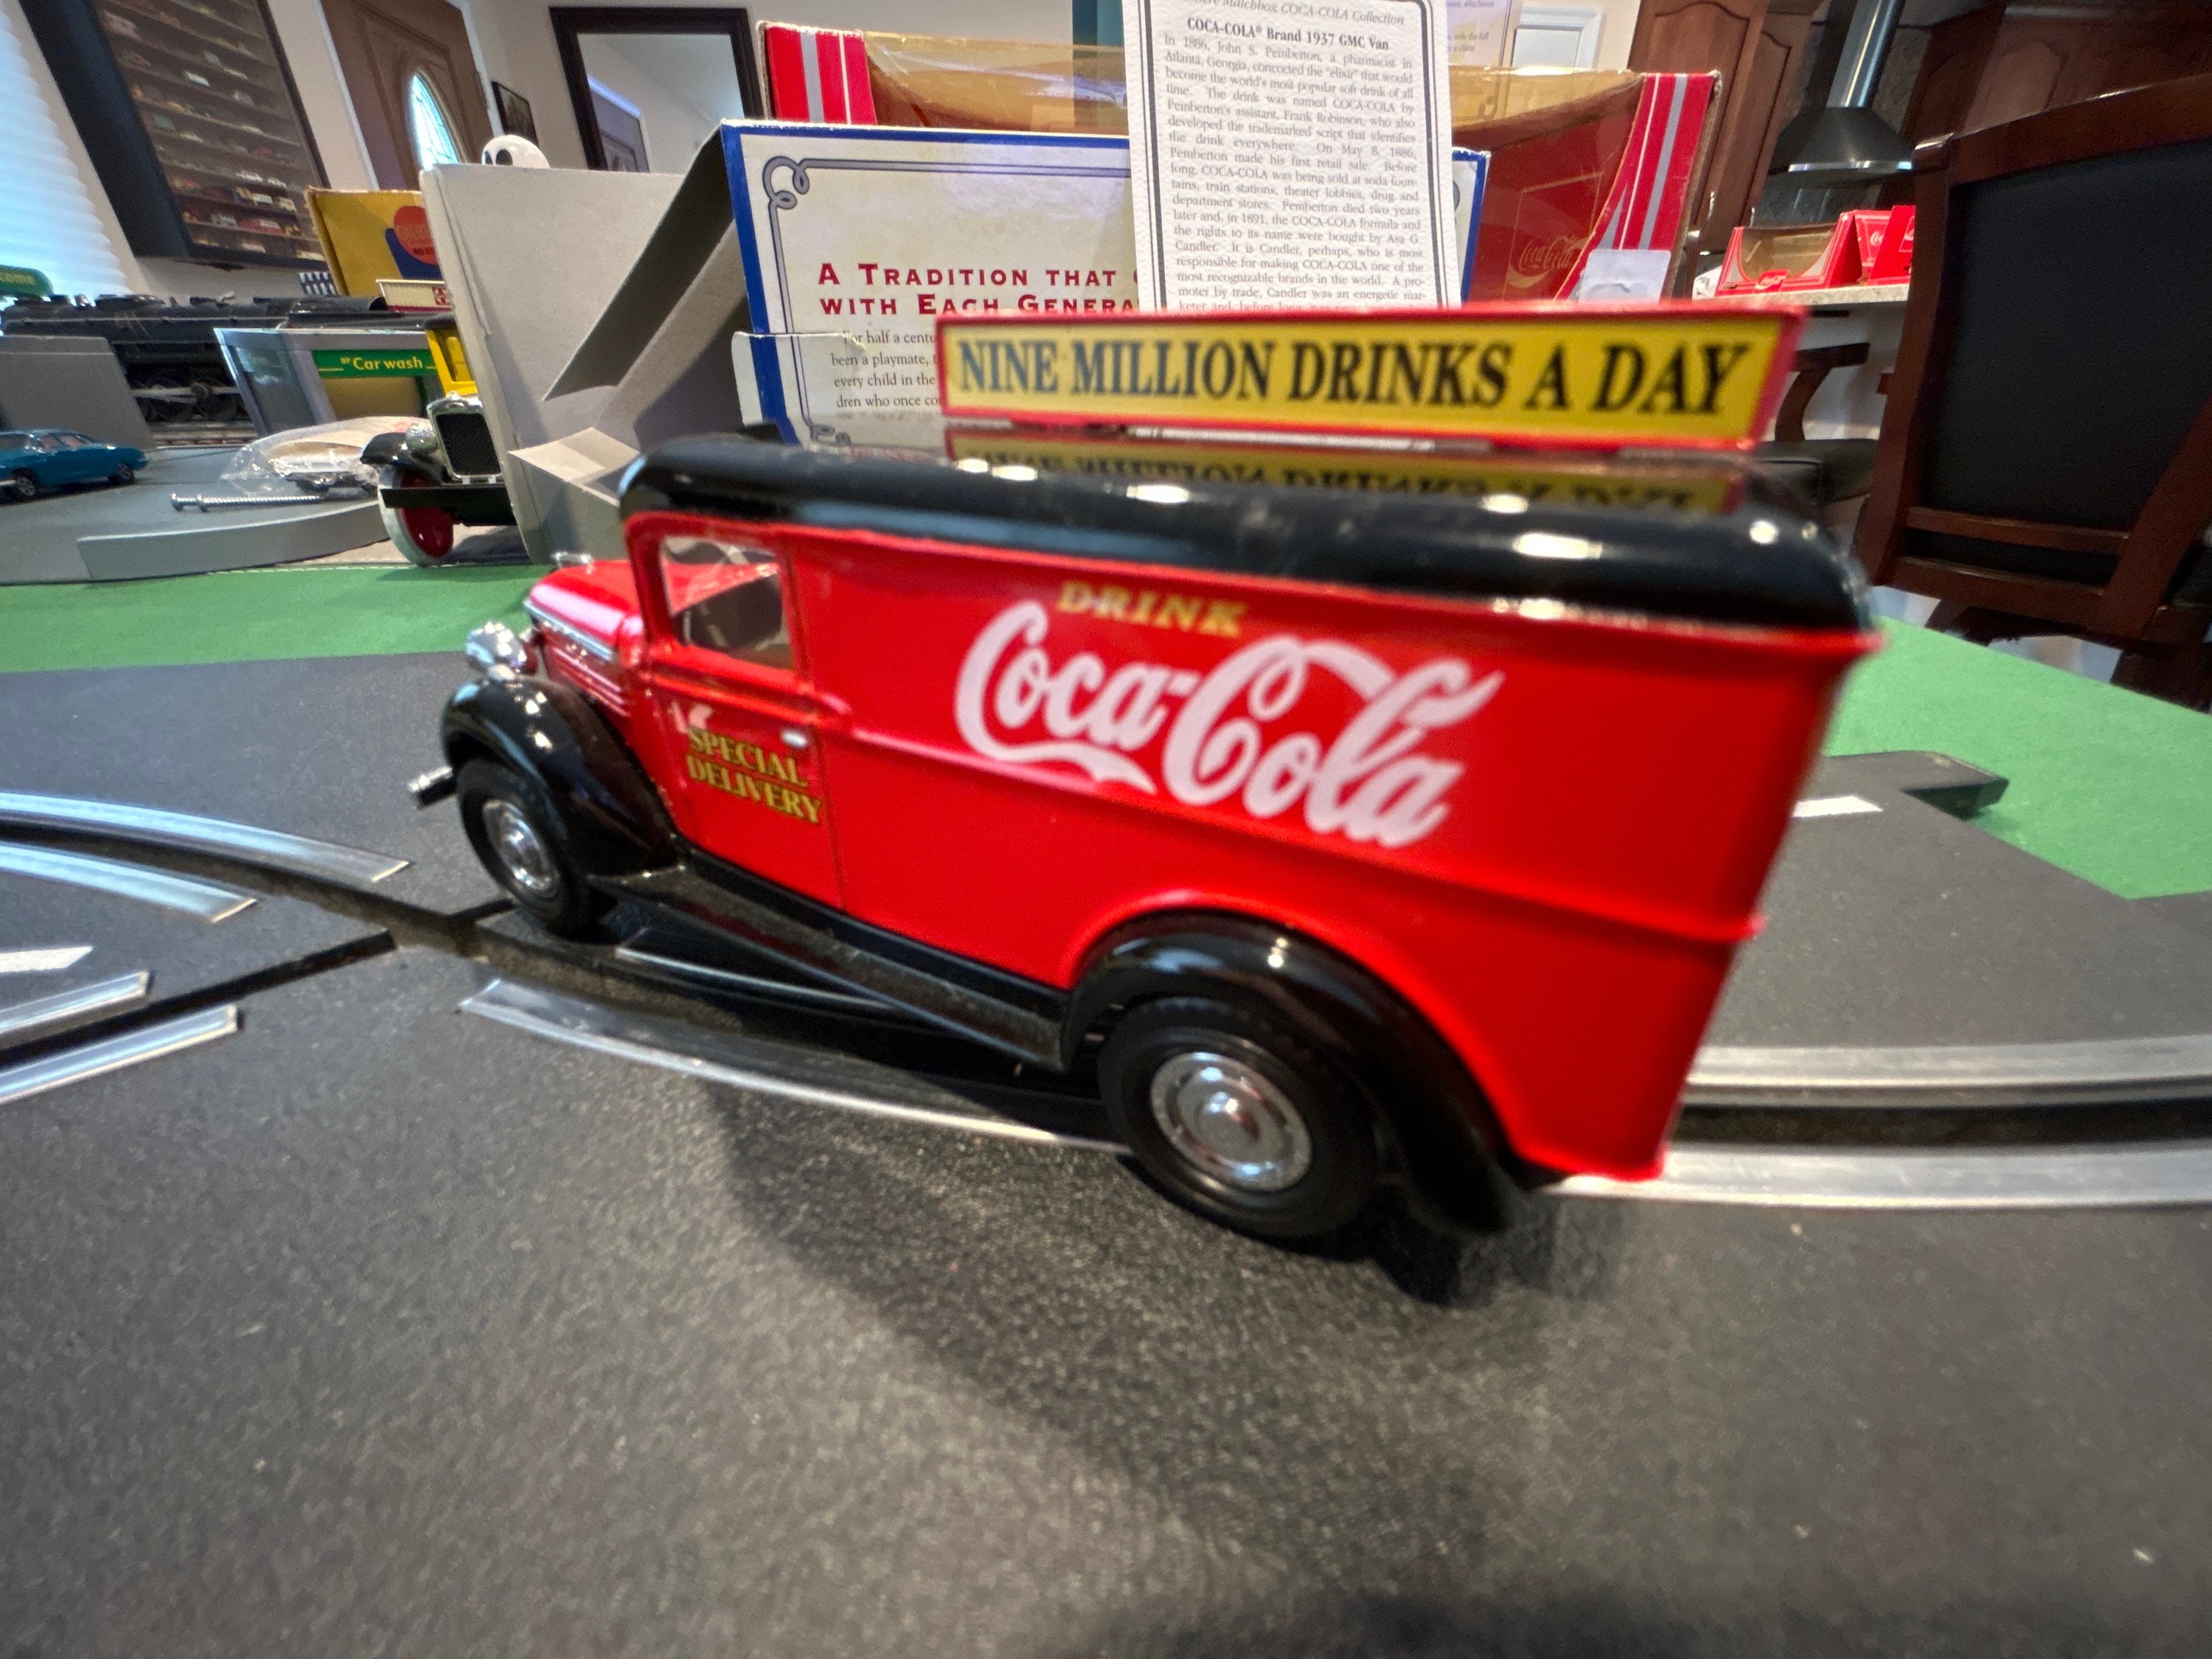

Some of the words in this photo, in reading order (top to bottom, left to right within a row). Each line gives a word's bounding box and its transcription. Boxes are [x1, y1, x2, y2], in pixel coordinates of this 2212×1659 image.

[1281, 3, 1348, 20] COCA-COLA
[1353, 10, 1403, 25] Collection
[1267, 28, 1301, 42] Brand
[1307, 31, 1335, 46] 1937
[1340, 35, 1365, 48] GMC
[1368, 38, 1388, 50] Van
[1165, 33, 1175, 45] In
[1217, 41, 1241, 54] John
[1343, 54, 1394, 68] pharmacist
[1403, 59, 1412, 68] in
[1166, 66, 1206, 81] become
[1211, 72, 1226, 83] the
[1231, 77, 1266, 87] world's
[1270, 80, 1293, 90] most
[1298, 82, 1336, 94] popular
[1340, 84, 1356, 94] soft
[1360, 87, 1385, 97] drink
[1389, 88, 1398, 97] of
[1402, 89, 1413, 98] all
[1253, 63, 1304, 74] concocted
[1307, 67, 1322, 77] the
[1361, 72, 1379, 81] that
[1383, 74, 1412, 83] would
[1208, 88, 1226, 100] The
[1233, 91, 1259, 102] drink
[1267, 96, 1286, 104] was
[1293, 97, 1326, 108] named
[1334, 100, 1394, 112] COCA-COLA
[1402, 103, 1413, 115] by
[1168, 100, 1231, 115] Pemberton's
[1284, 111, 1312, 122] Frank
[1371, 116, 1391, 127] who
[1397, 119, 1415, 128] also
[1169, 116, 1222, 131] developed
[1228, 121, 1243, 132] the
[1249, 124, 1311, 136] trademarked
[1317, 129, 1343, 140] script
[1348, 130, 1366, 139] that
[1371, 132, 1416, 143] identifies
[1169, 131, 1186, 142] the
[1196, 133, 1224, 146] drink
[1317, 143, 1332, 153] On
[1342, 145, 1363, 156] May
[1171, 148, 1228, 161] Pemberton
[1235, 153, 1263, 164] made
[1270, 155, 1284, 164] his
[1292, 156, 1310, 167] first
[1318, 159, 1341, 169] retail
[1385, 161, 1417, 172] Before
[1202, 165, 1267, 179] COCA-COLA
[1273, 172, 1292, 181] was
[1295, 171, 1324, 184] being
[1328, 174, 1348, 184] sold
[1353, 176, 1361, 184] at
[1365, 176, 1387, 185] soda
[1172, 180, 1199, 192] tains,
[1206, 182, 1230, 192] train
[1237, 185, 1278, 195] stations,
[1285, 186, 1320, 198] theater
[1371, 190, 1394, 203] drug
[1401, 192, 1418, 201] and
[1173, 194, 1233, 207] department
[1283, 201, 1337, 212] Pemberton
[1343, 204, 1364, 213] died
[1370, 206, 1388, 214] two
[1394, 207, 1419, 217] years
[1174, 209, 1196, 220] later
[1228, 214, 1237, 222] in
[1272, 215, 1288, 225] the
[1292, 216, 1356, 228] COCA-COLA
[1360, 220, 1398, 229] formula
[1402, 220, 1420, 230] and
[1175, 225, 1191, 235] the
[1197, 226, 1226, 238] rights
[1232, 229, 1242, 237] to
[1248, 229, 1259, 238] its
[1265, 230, 1293, 240] name
[1298, 231, 1324, 240] were
[1329, 232, 1364, 243] bought
[1370, 232, 1382, 245] by
[1388, 234, 1404, 243] Asa
[1232, 243, 1239, 252] It
[1246, 244, 1253, 253] is
[1358, 248, 1380, 257] who
[1385, 248, 1393, 257] is
[1399, 249, 1422, 257] most
[818, 263, 840, 285] A
[858, 263, 1027, 285] TRADITION
[1046, 270, 1116, 285] THAT
[1177, 257, 1237, 269] responsible
[1242, 258, 1256, 267] for
[1261, 259, 1298, 271] making
[1303, 260, 1366, 271] COCA-COLA
[1394, 263, 1404, 271] of
[1408, 263, 1423, 272] the
[1178, 273, 1203, 282] most
[1208, 273, 1273, 284] recognizable
[1279, 274, 1313, 284] brands
[1318, 274, 1326, 284] in
[1332, 274, 1347, 284] the
[1393, 276, 1399, 285] A
[1405, 278, 1425, 288] pro-
[820, 299, 897, 315] WITH
[918, 293, 998, 314] EACH
[1018, 294, 1139, 314] GENERA
[1179, 288, 1209, 296] moter
[1214, 286, 1227, 299] by
[1267, 288, 1307, 299] Candler
[1354, 291, 1398, 301] energetic
[1404, 291, 1426, 300] mar-
[866, 330, 890, 343] half
[894, 334, 900, 343] a
[353, 357, 380, 369] Car
[383, 356, 422, 369] wash
[832, 353, 858, 366] been
[863, 357, 868, 365] a
[873, 352, 928, 367] playmate,
[835, 377, 863, 389] every
[868, 374, 897, 386] child
[902, 375, 913, 384] in
[917, 372, 935, 385] the
[959, 339, 1057, 394] NINE
[1071, 341, 1275, 402] MILLION
[1289, 342, 1508, 410] DRINKS
[1520, 345, 1571, 411] A
[1590, 341, 1750, 414] DAY
[837, 395, 861, 408] dren
[866, 394, 890, 406] who
[894, 397, 920, 406] once
[925, 397, 939, 406] co
[1059, 582, 1248, 639] DRINK
[955, 601, 1506, 849] Coca-Cola
[687, 726, 807, 787] SPECIAL
[686, 753, 821, 824] DELIVERY
